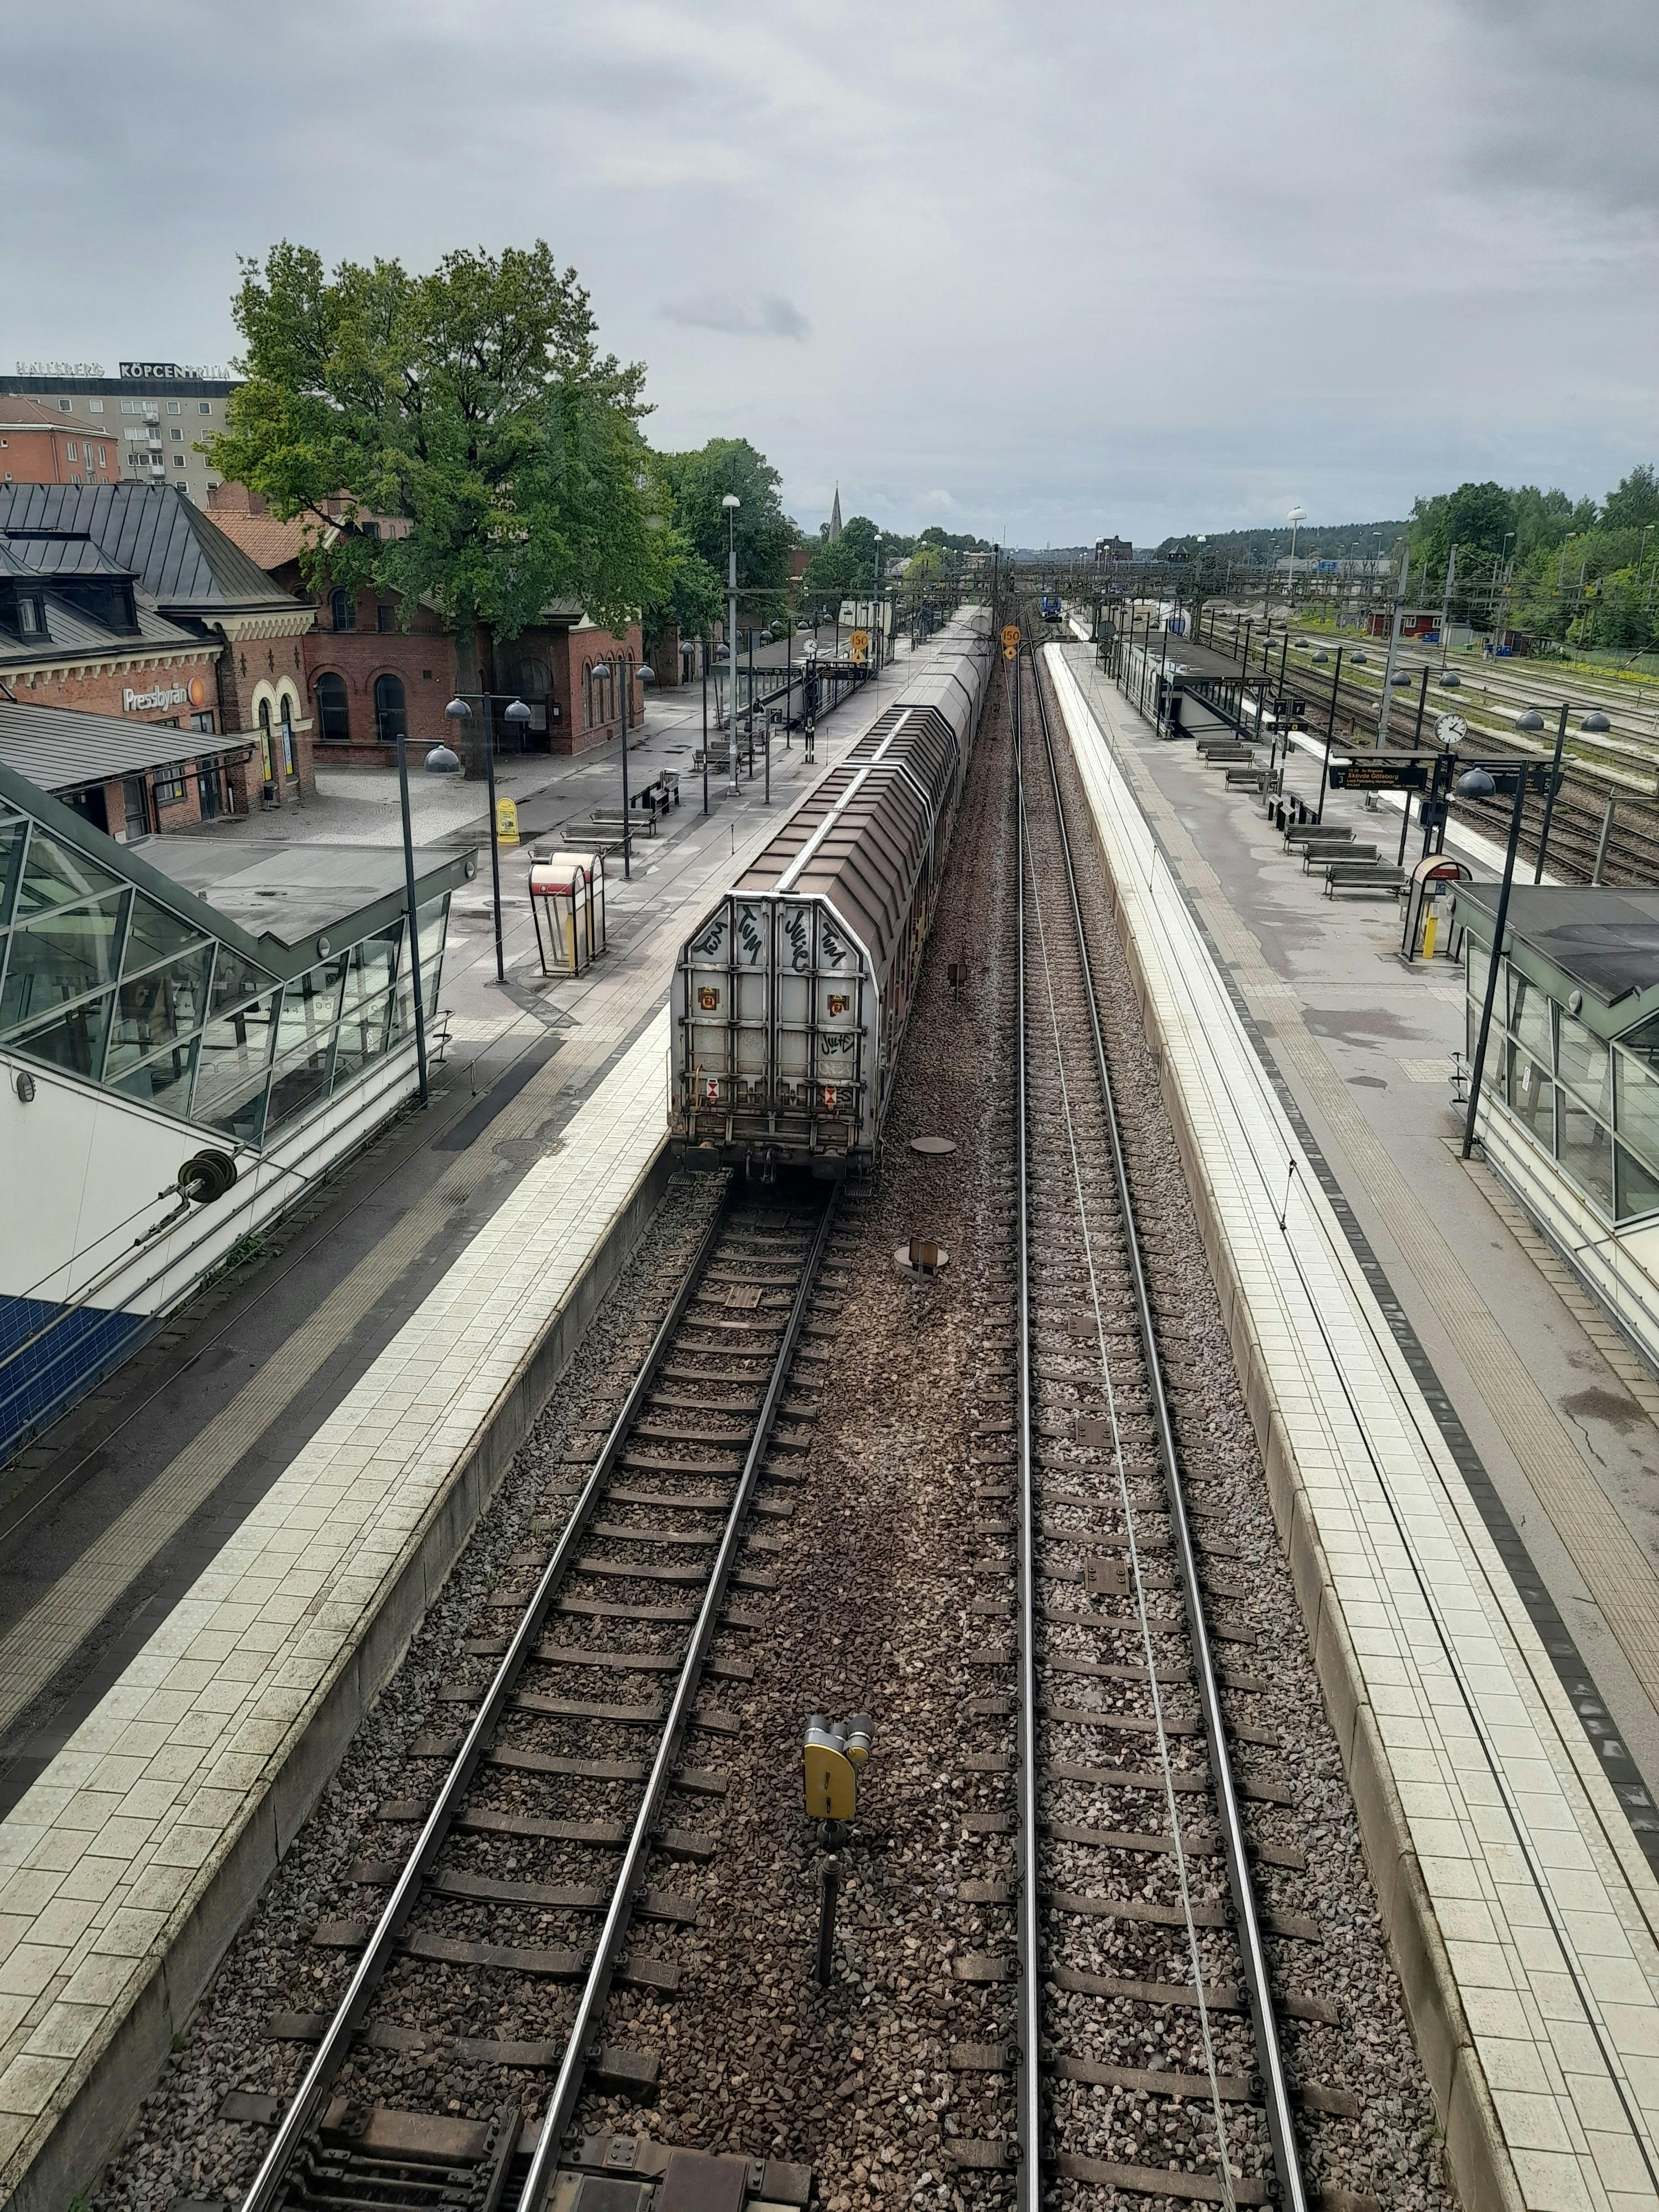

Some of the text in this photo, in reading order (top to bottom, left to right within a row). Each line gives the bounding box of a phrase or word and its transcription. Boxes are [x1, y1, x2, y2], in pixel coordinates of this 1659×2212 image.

[15, 361, 105, 377] HALLSBERG
[121, 363, 230, 379] KÖPCENTRUM
[852, 636, 868, 645] 150
[1003, 631, 1019, 640] 150
[123, 682, 187, 712] Pressbyrån
